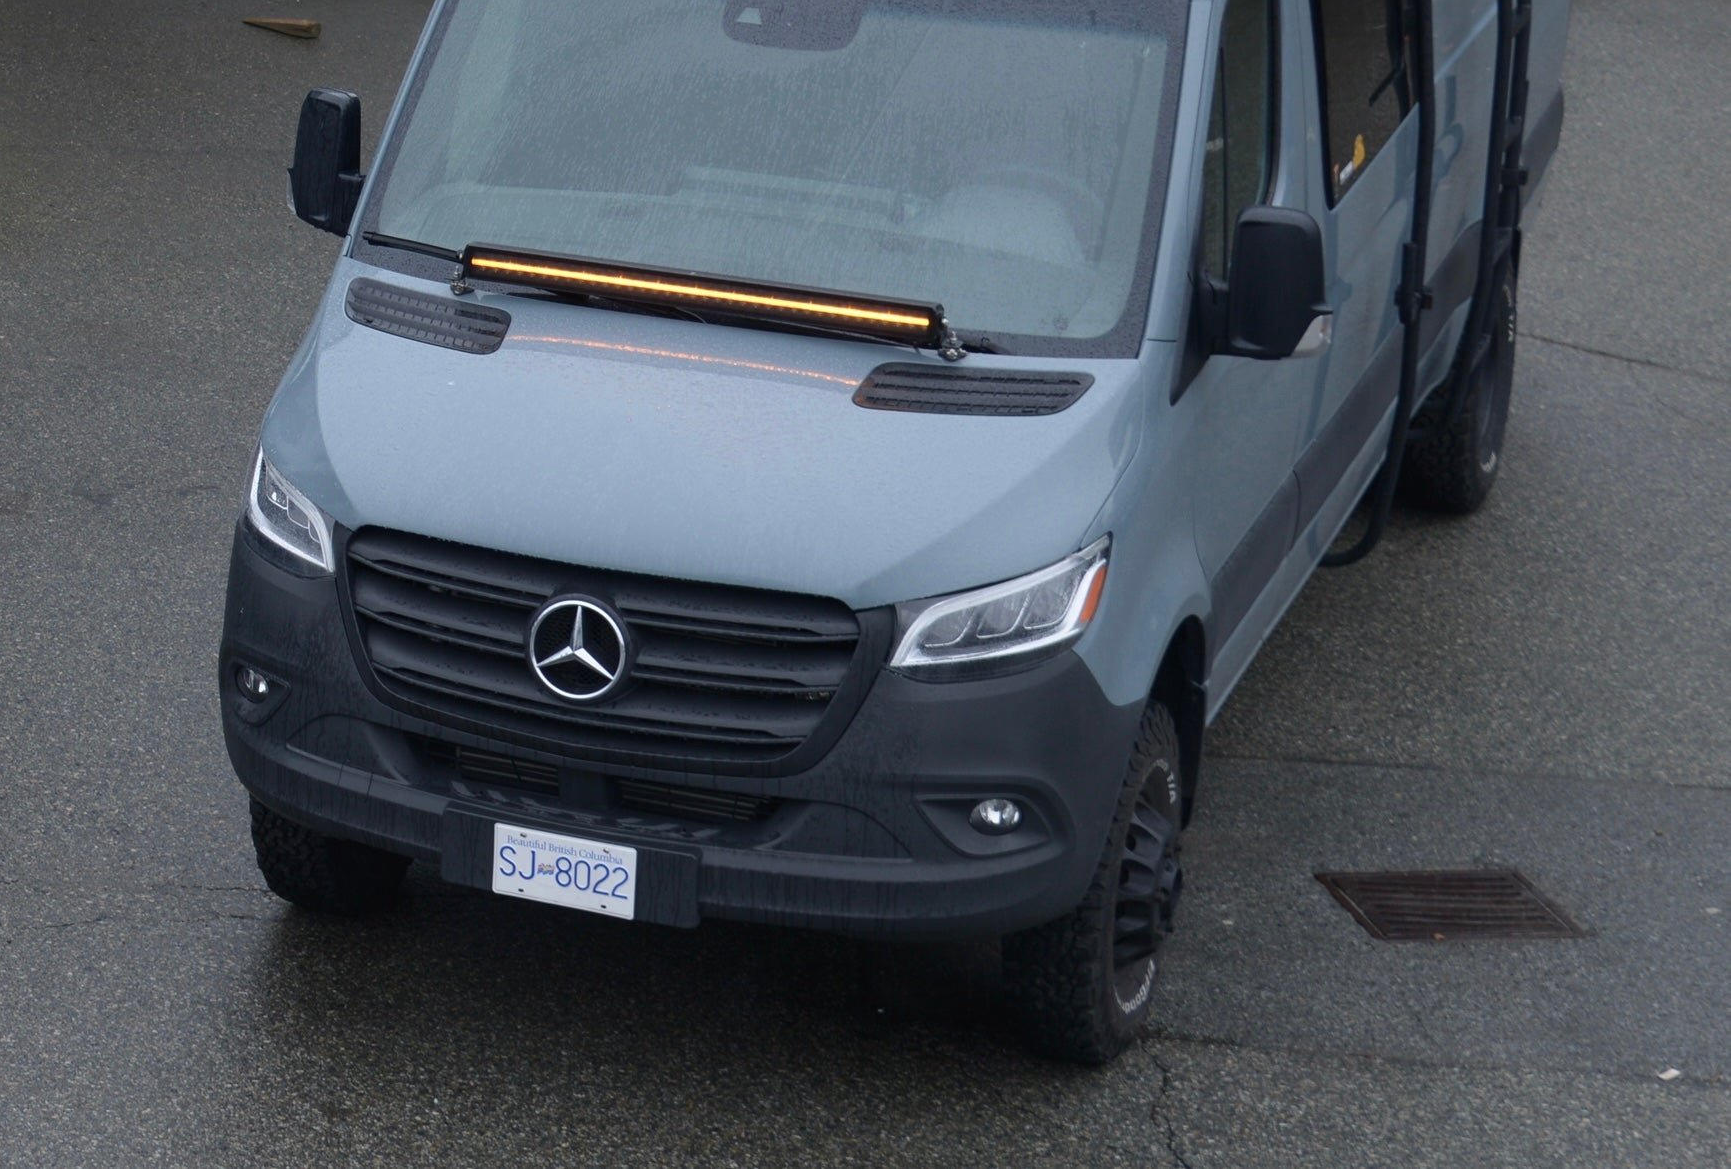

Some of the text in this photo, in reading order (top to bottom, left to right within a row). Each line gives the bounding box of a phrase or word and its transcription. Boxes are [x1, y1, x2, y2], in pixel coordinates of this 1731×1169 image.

[506, 834, 623, 865] Beautiful British Columbia
[555, 856, 629, 900] 8022
